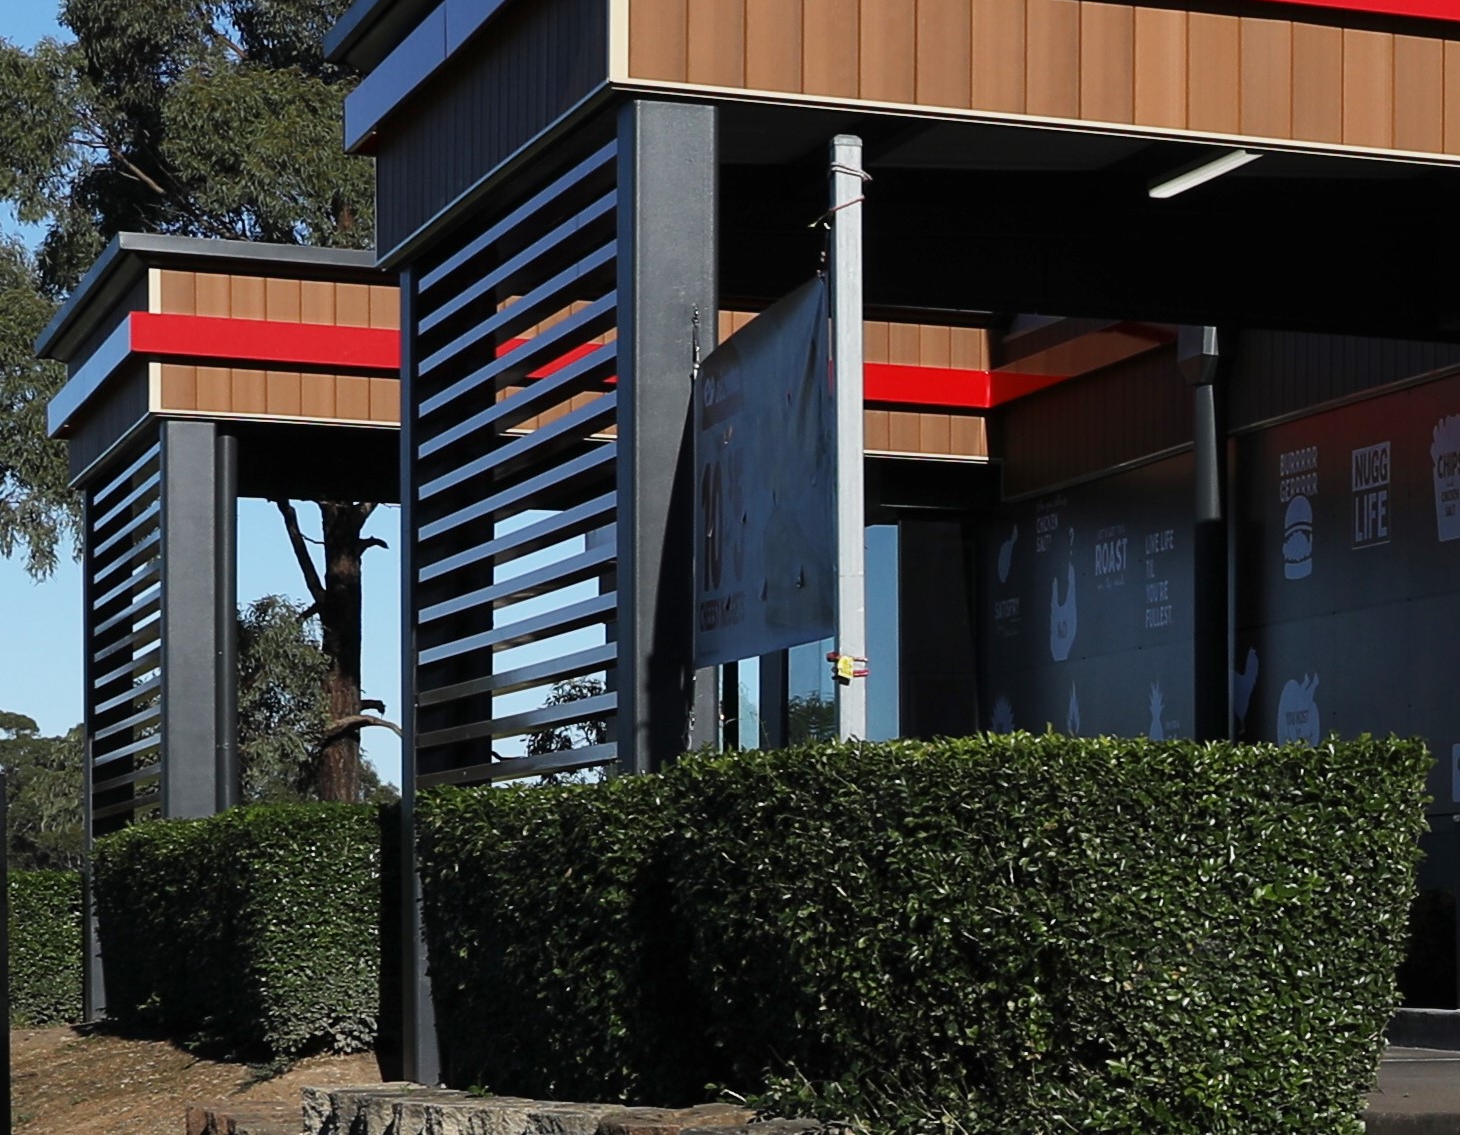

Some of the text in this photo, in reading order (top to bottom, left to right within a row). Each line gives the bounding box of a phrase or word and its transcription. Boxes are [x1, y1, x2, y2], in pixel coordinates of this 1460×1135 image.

[1354, 447, 1388, 488] NUGG
[1354, 489, 1388, 543] LIFE
[1094, 537, 1129, 577] ROAST
